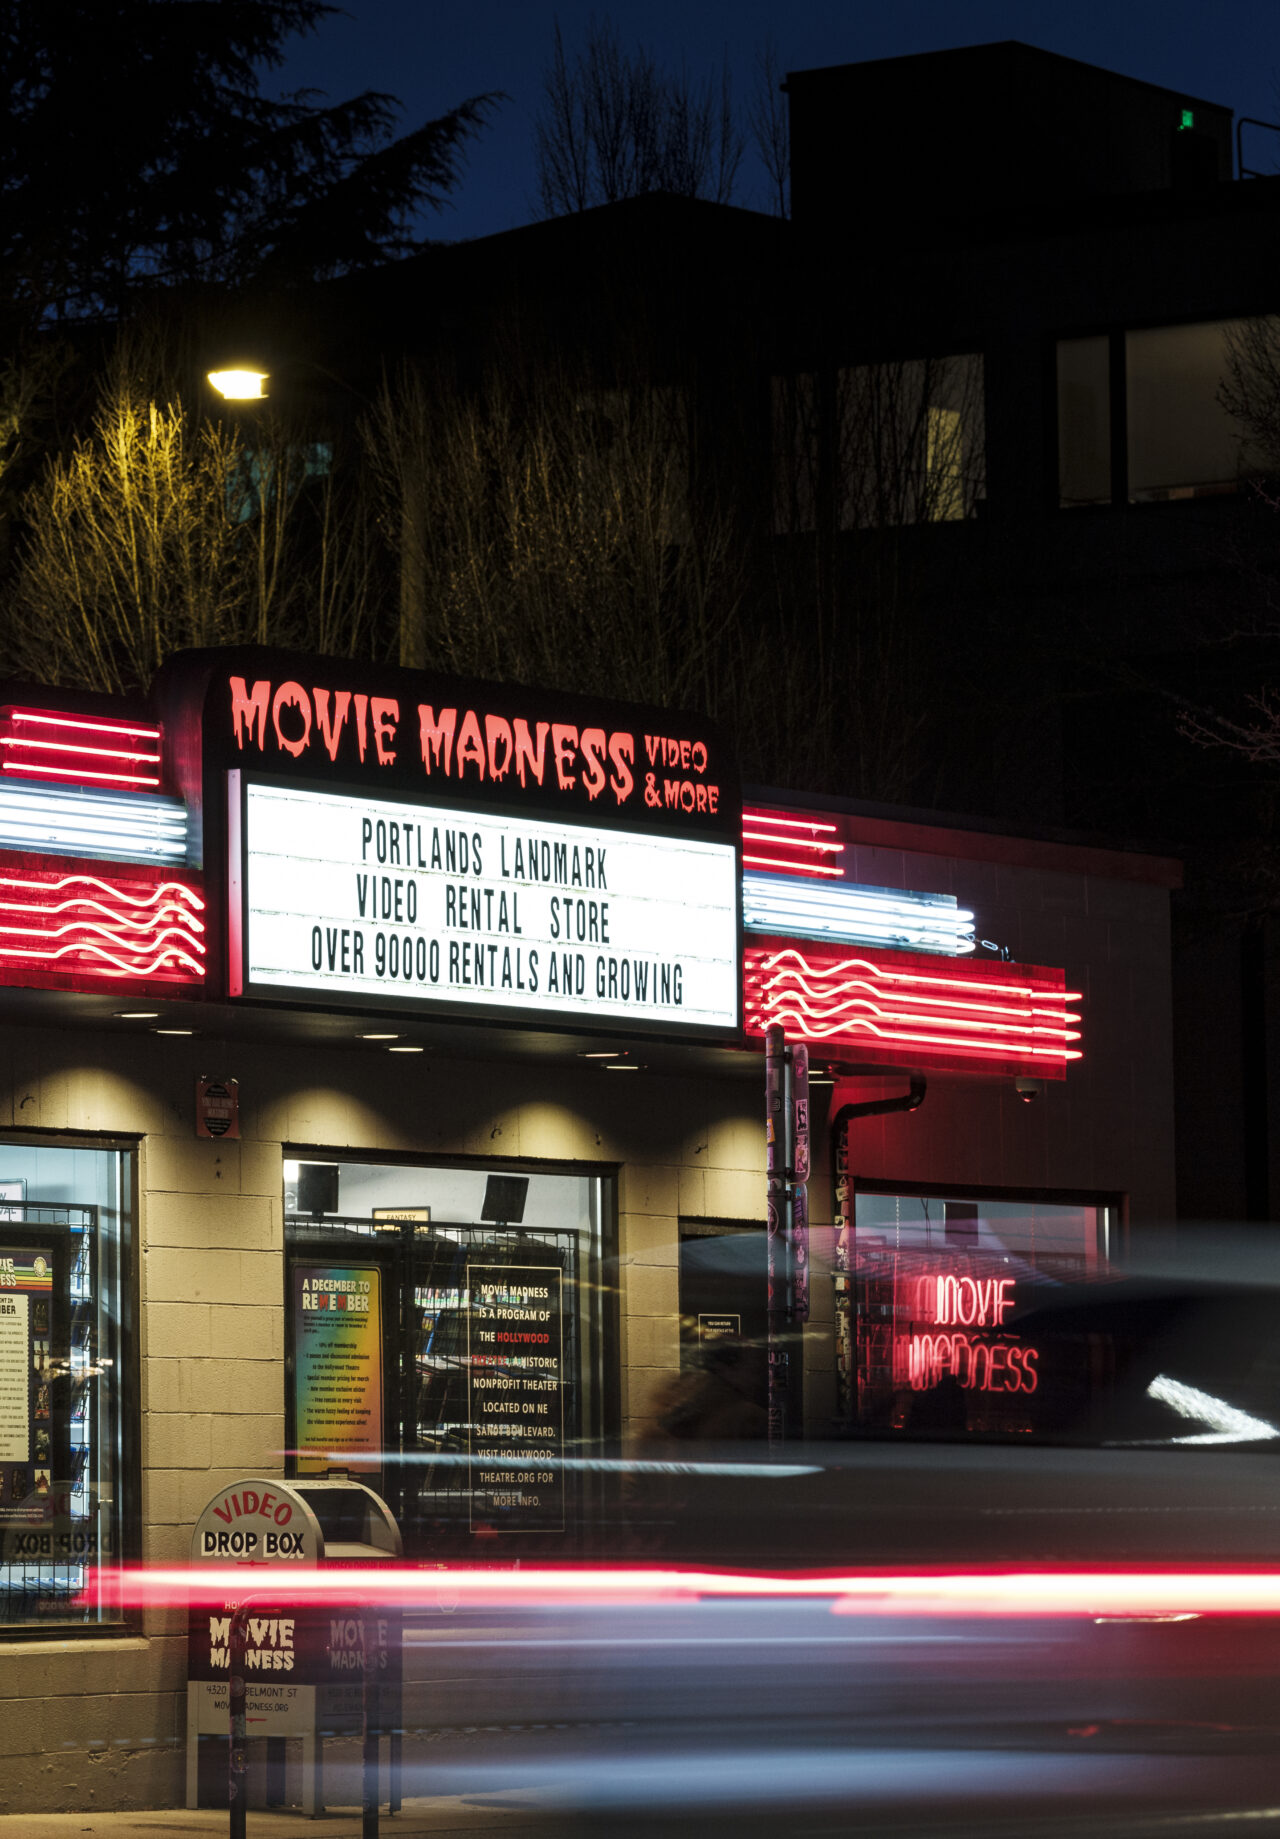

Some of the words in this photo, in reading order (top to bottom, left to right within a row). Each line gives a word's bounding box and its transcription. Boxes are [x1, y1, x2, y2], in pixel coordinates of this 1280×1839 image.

[229, 676, 399, 766] MOVIE
[418, 704, 634, 805] MADNESS
[644, 734, 708, 774] VIDEO
[362, 816, 483, 876] PORTLANDS
[500, 834, 608, 890] LANDMARK
[356, 873, 418, 925] VIDEO
[446, 884, 522, 935] RENTAL
[550, 896, 610, 944] STORE
[311, 925, 365, 976] OVER
[374, 931, 440, 983] 90000
[449, 941, 539, 993] RENTALS
[548, 953, 586, 996] AND
[595, 956, 683, 1006] GROWING
[302, 1278, 310, 1291] A
[312, 1279, 356, 1292] DECEMBER
[359, 1281, 370, 1293] TO
[481, 1285, 507, 1296] MOVIE
[509, 1286, 548, 1298] MADNESS
[302, 1293, 369, 1312] REMEMBER
[479, 1308, 487, 1318] IS
[489, 1309, 495, 1319] A
[497, 1309, 537, 1320] PROGRAM
[539, 1311, 551, 1321] OF
[480, 1331, 495, 1342] THE
[497, 1332, 550, 1343] HOLLYWOOD
[513, 1356, 518, 1367] A
[520, 1356, 558, 1368] HISTORIC
[473, 1378, 520, 1389] NONPROFIT
[522, 1379, 558, 1391] THEATER
[483, 1402, 520, 1413] LOCATED
[522, 1403, 535, 1414] ON
[537, 1404, 548, 1414] NE
[476, 1425, 504, 1436] SANDY
[506, 1426, 556, 1437] BOULEVARD.
[478, 1449, 498, 1460] VISIT
[500, 1450, 555, 1460] HOLLYWOOD-
[480, 1472, 535, 1483] THEATRE.ORG
[537, 1473, 554, 1483] FOR
[212, 1490, 293, 1526] VIDEO
[493, 1496, 517, 1507] MORE
[202, 1532, 258, 1557] DROP
[265, 1532, 305, 1558] BOX
[210, 1616, 295, 1648] MVIE
[330, 1619, 389, 1647] MOVE
[210, 1648, 295, 1671] MNESS
[330, 1650, 389, 1669] MADNS
[206, 1686, 227, 1695] 4320
[245, 1686, 283, 1697] BELMONT
[287, 1688, 298, 1698] ST
